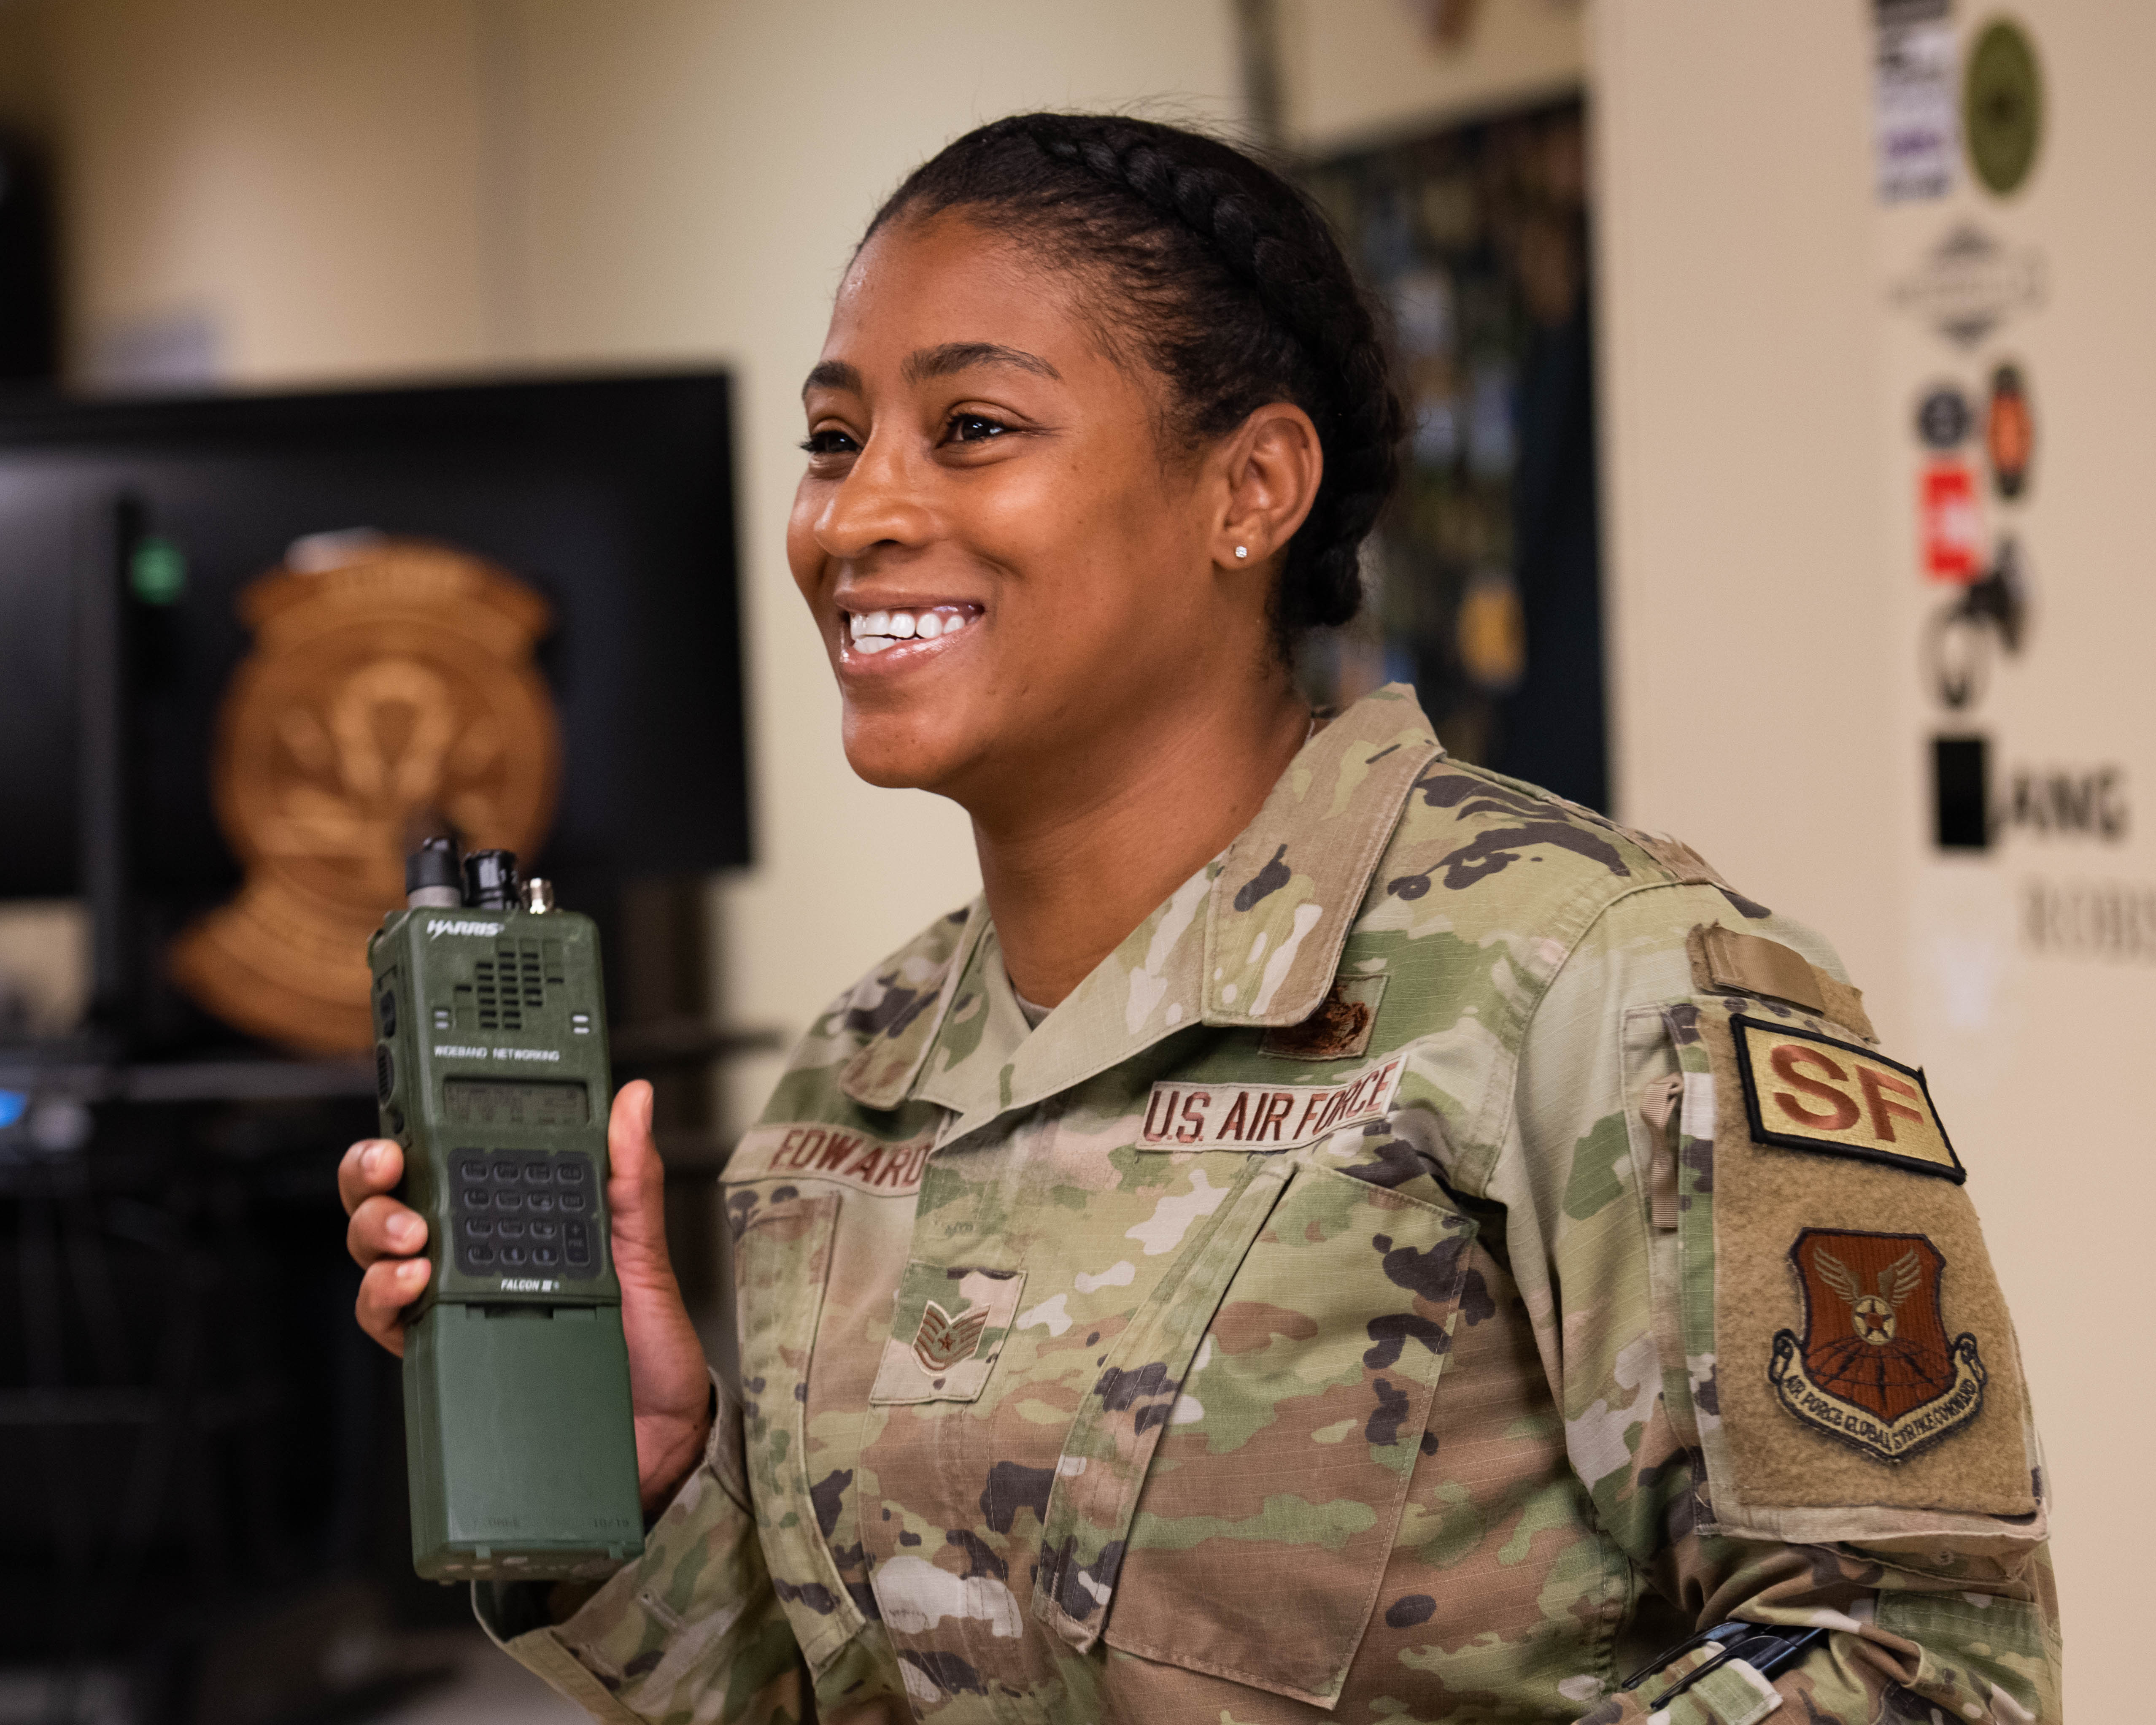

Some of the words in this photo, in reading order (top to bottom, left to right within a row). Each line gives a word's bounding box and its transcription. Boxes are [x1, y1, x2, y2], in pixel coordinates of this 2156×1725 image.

[426, 920, 500, 942] HARRIS
[434, 1045, 488, 1059] WIDEBAND
[493, 1047, 560, 1062] NETWORKING
[1142, 1090, 1211, 1143] U.S.
[1216, 1091, 1295, 1141] AIR
[1293, 1061, 1398, 1140] FORCE
[1770, 1044, 1924, 1143] SF
[501, 1278, 540, 1291] FALCON
[1785, 1374, 1806, 1399] AIR
[1800, 1391, 1844, 1426] FORCE
[1892, 1416, 1935, 1450] STRIKE
